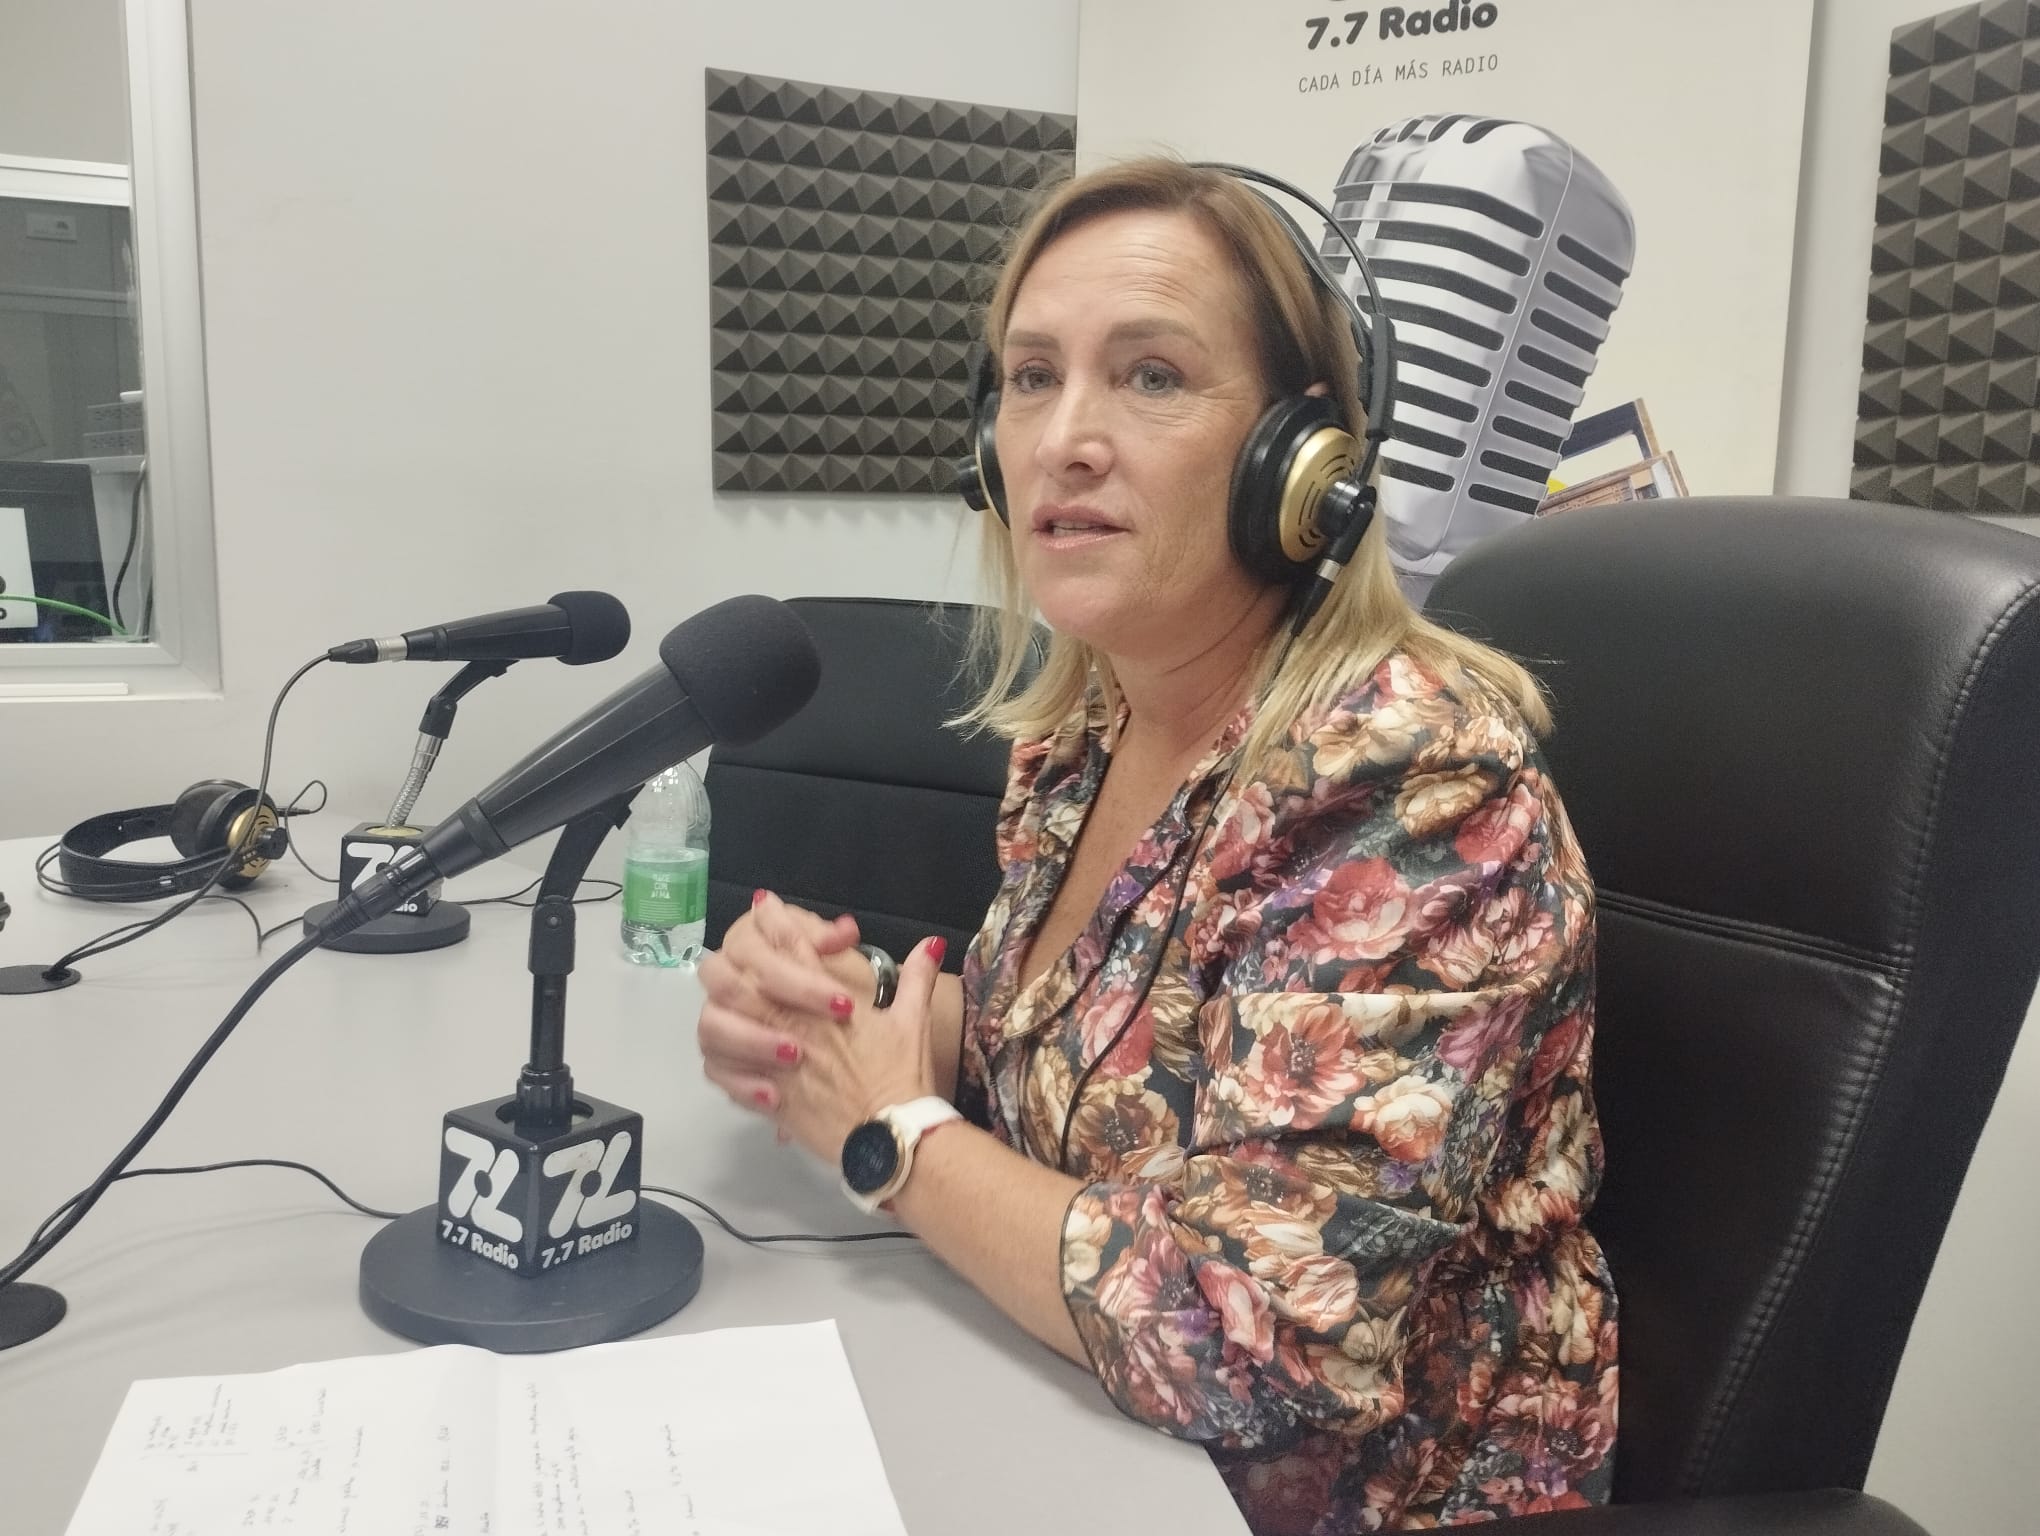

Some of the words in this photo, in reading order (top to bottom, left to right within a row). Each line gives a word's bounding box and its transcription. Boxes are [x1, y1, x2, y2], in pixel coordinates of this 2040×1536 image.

[1305, 11, 1369, 50] 7.7
[1379, 0, 1498, 40] Radio
[1299, 73, 1340, 93] CADA
[1352, 64, 1383, 87] DÍA
[1395, 58, 1429, 81] MÁS
[1442, 54, 1498, 76] RADIO
[441, 1219, 469, 1245] 7.7
[471, 1232, 519, 1269] Radio
[541, 1240, 575, 1269] 7.7
[578, 1221, 633, 1255] Radio
